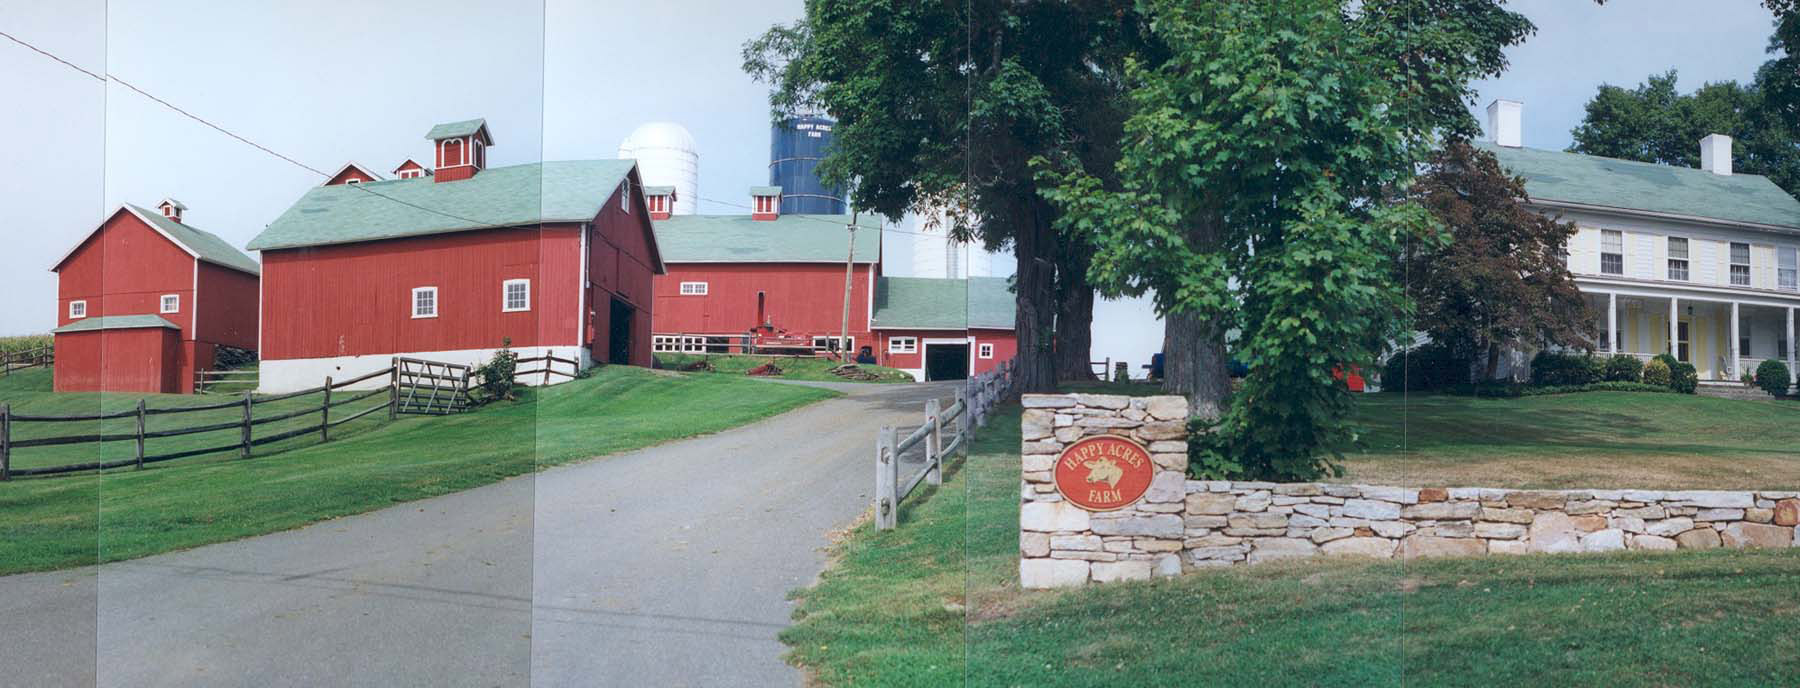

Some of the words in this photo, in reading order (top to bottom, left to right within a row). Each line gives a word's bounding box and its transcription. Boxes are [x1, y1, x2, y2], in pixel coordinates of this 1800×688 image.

[1064, 442, 1104, 471] HAPPY
[1108, 443, 1144, 468] ACRES
[1088, 489, 1122, 503] FARM
